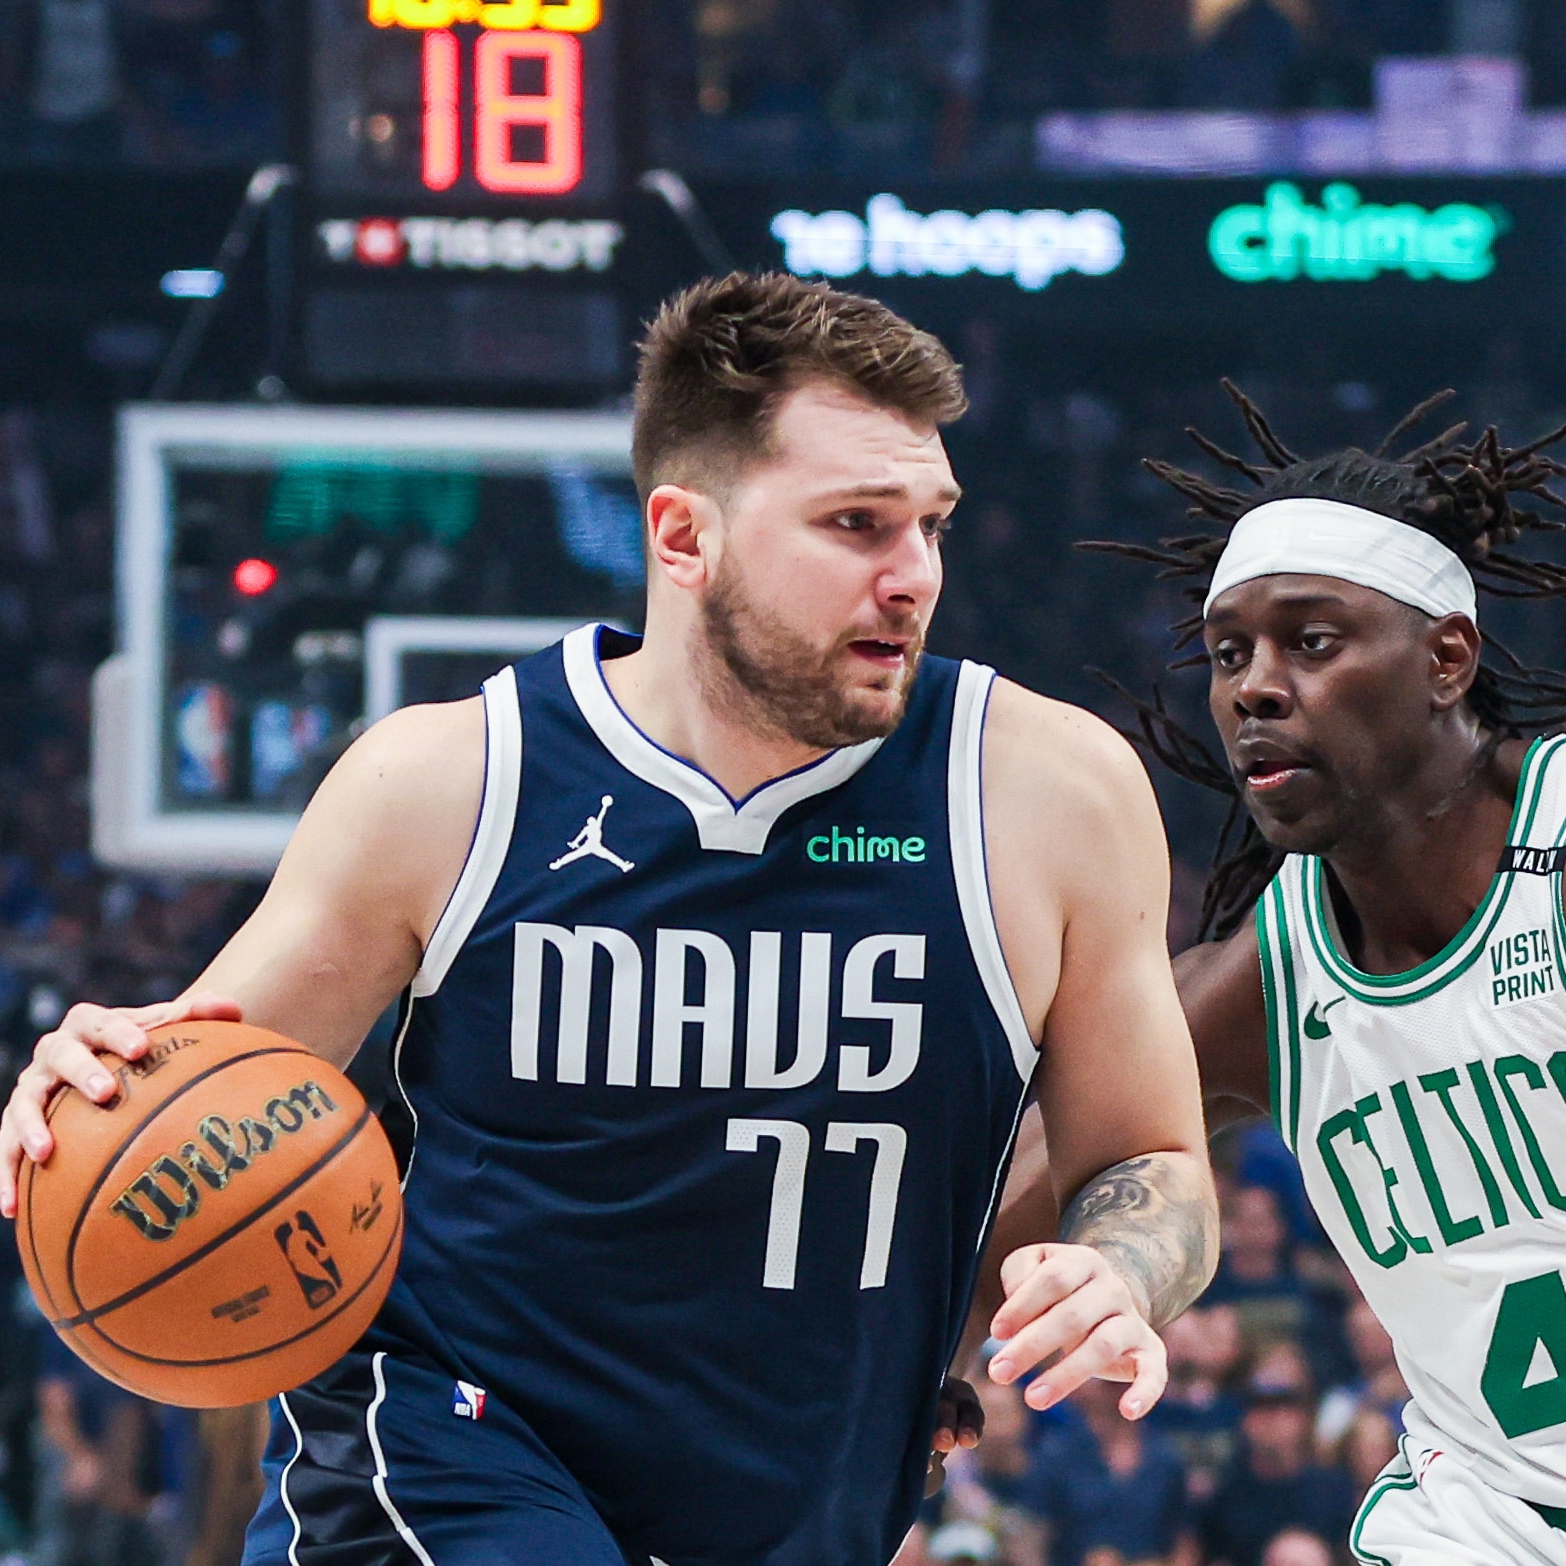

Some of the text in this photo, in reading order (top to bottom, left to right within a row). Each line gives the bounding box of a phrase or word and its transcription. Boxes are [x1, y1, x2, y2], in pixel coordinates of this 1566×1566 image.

[422, 27, 583, 194] 18
[403, 217, 624, 271] TISSOT
[866, 193, 1125, 291] hoops
[1208, 182, 1497, 282] chime
[806, 826, 926, 863] chime
[1490, 929, 1552, 977] VISTA
[1492, 964, 1554, 1006] PRINT
[510, 921, 927, 1093] MAVS
[109, 1080, 341, 1242] Wilson
[725, 1118, 907, 1291] 77
